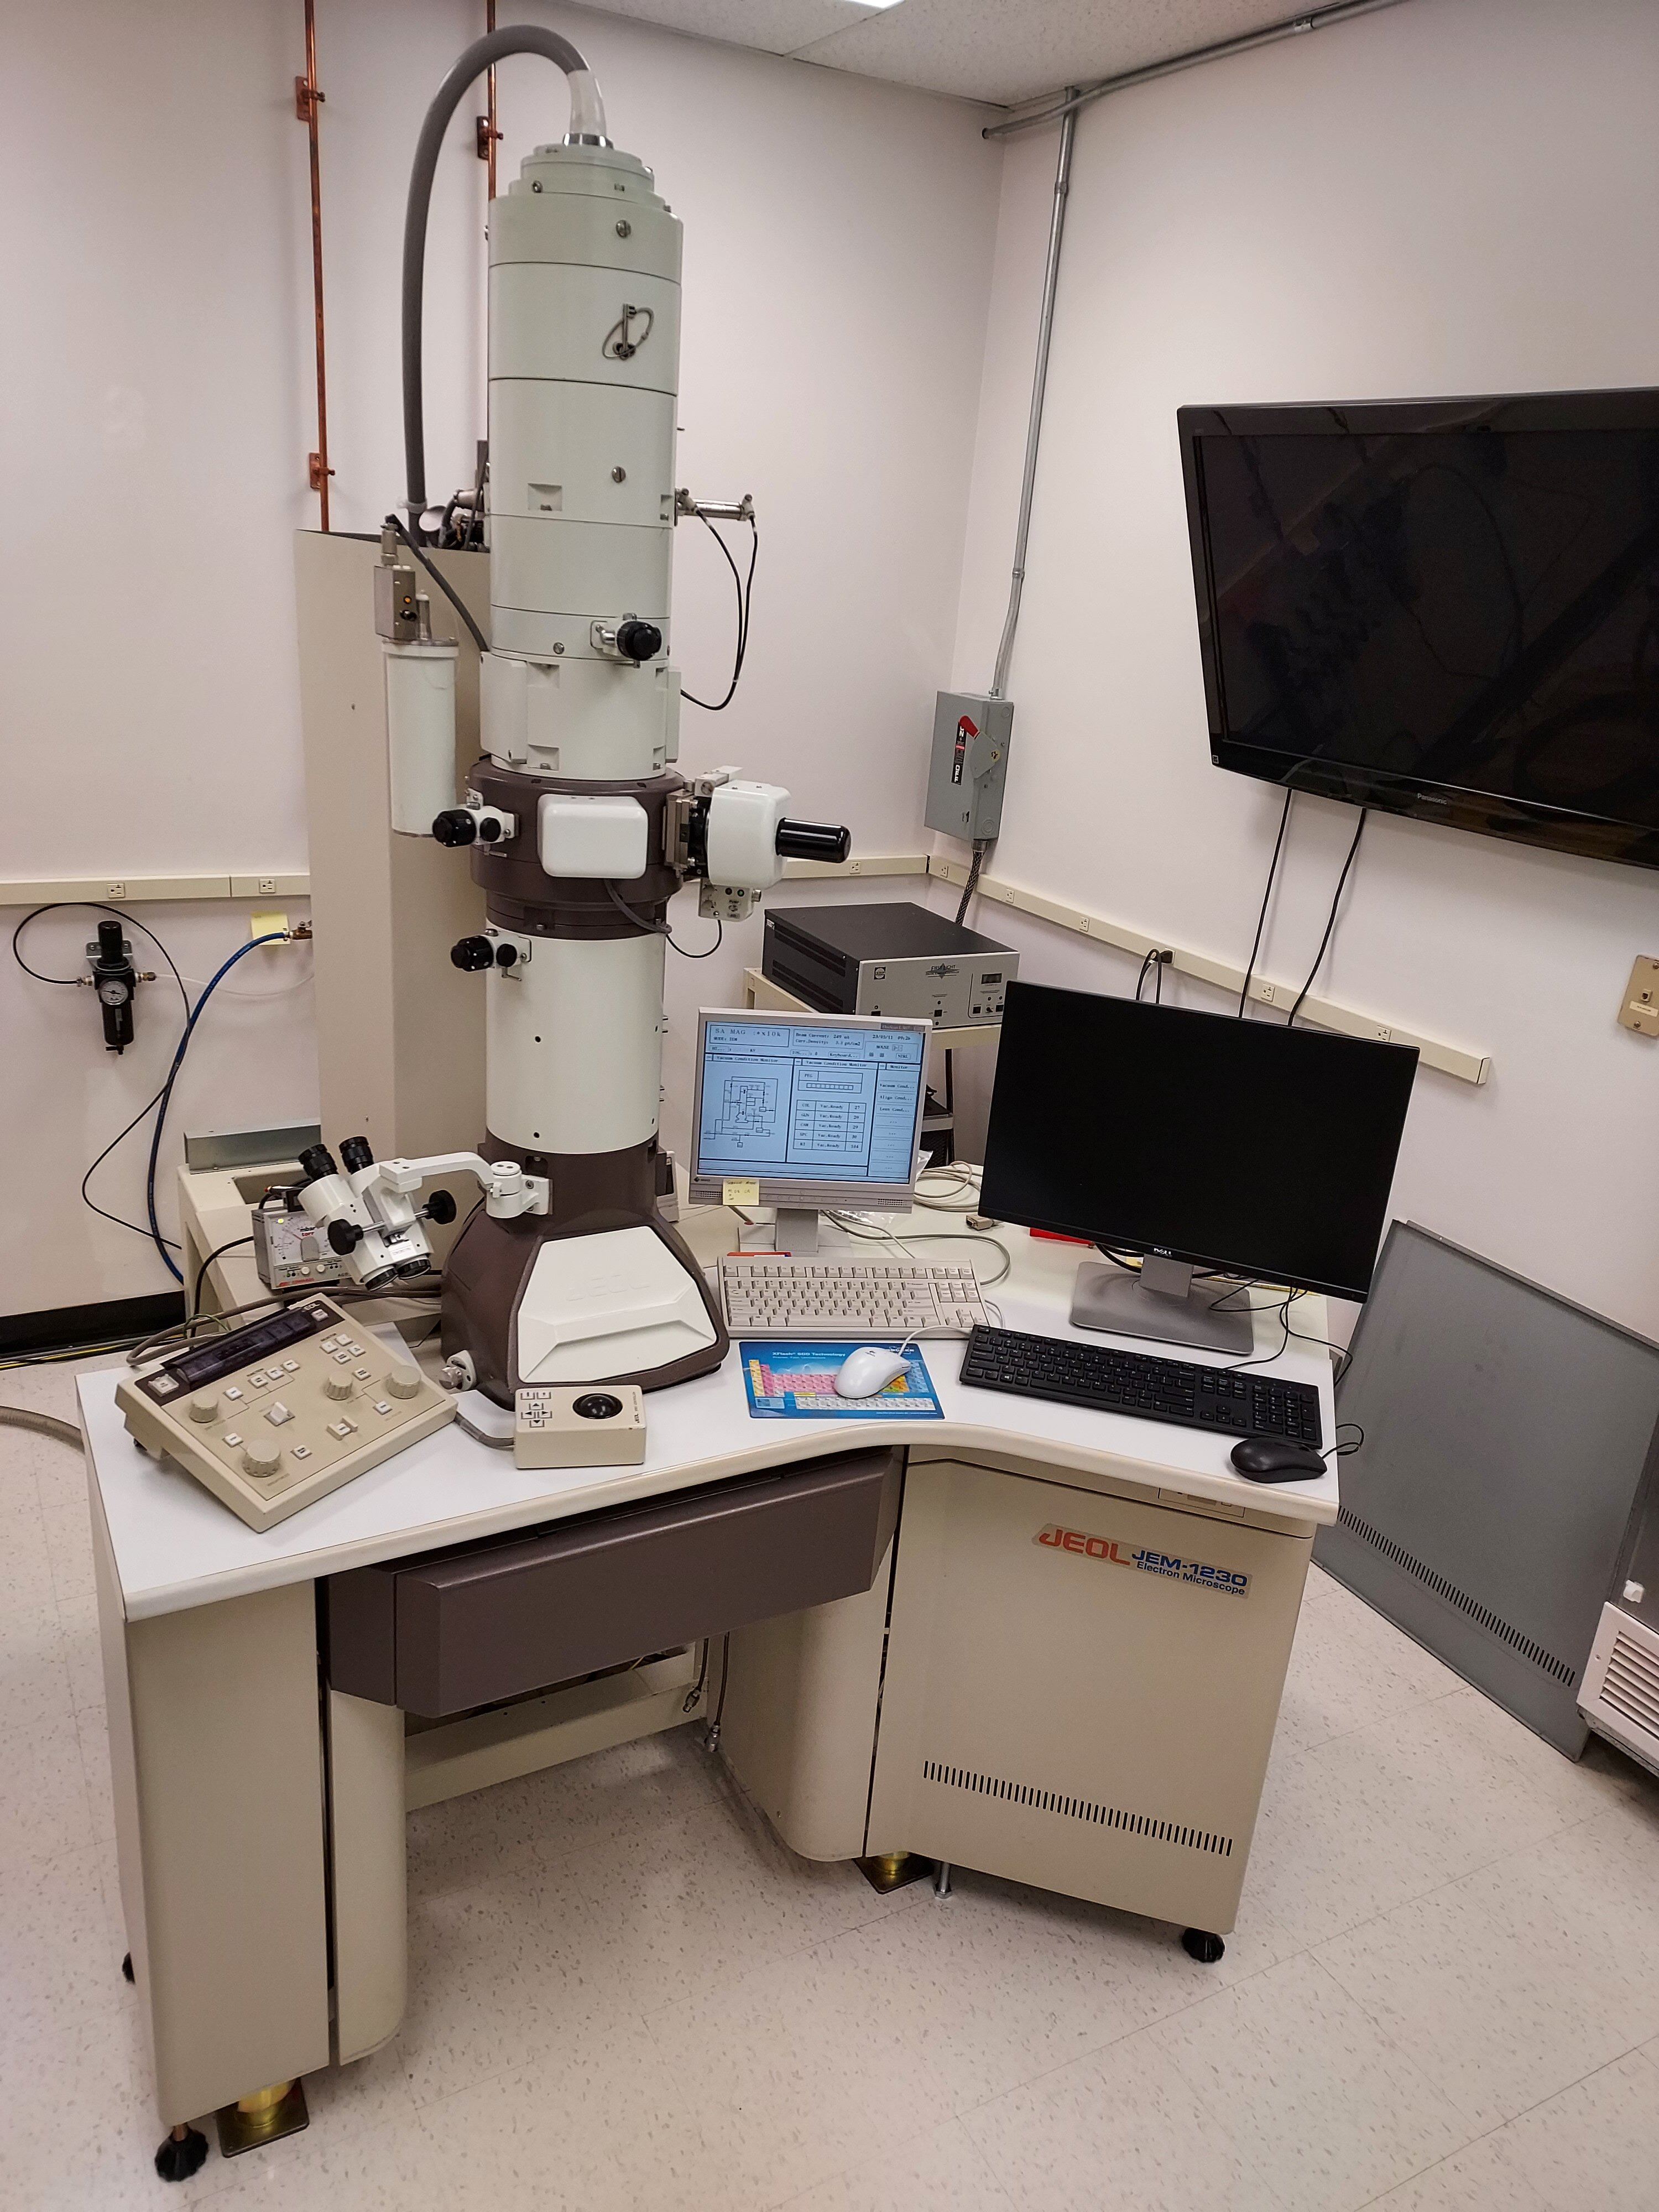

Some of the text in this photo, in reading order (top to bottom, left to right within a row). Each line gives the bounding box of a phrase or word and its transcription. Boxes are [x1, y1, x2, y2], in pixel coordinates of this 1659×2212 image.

[1417, 793, 1447, 805] Panasonic
[566, 1274, 650, 1301] JEOL
[301, 1302, 320, 1313] EOL
[1039, 1528, 1248, 1587] JEOL JEM-1230
[1136, 1561, 1245, 1595] Electron Microscope
